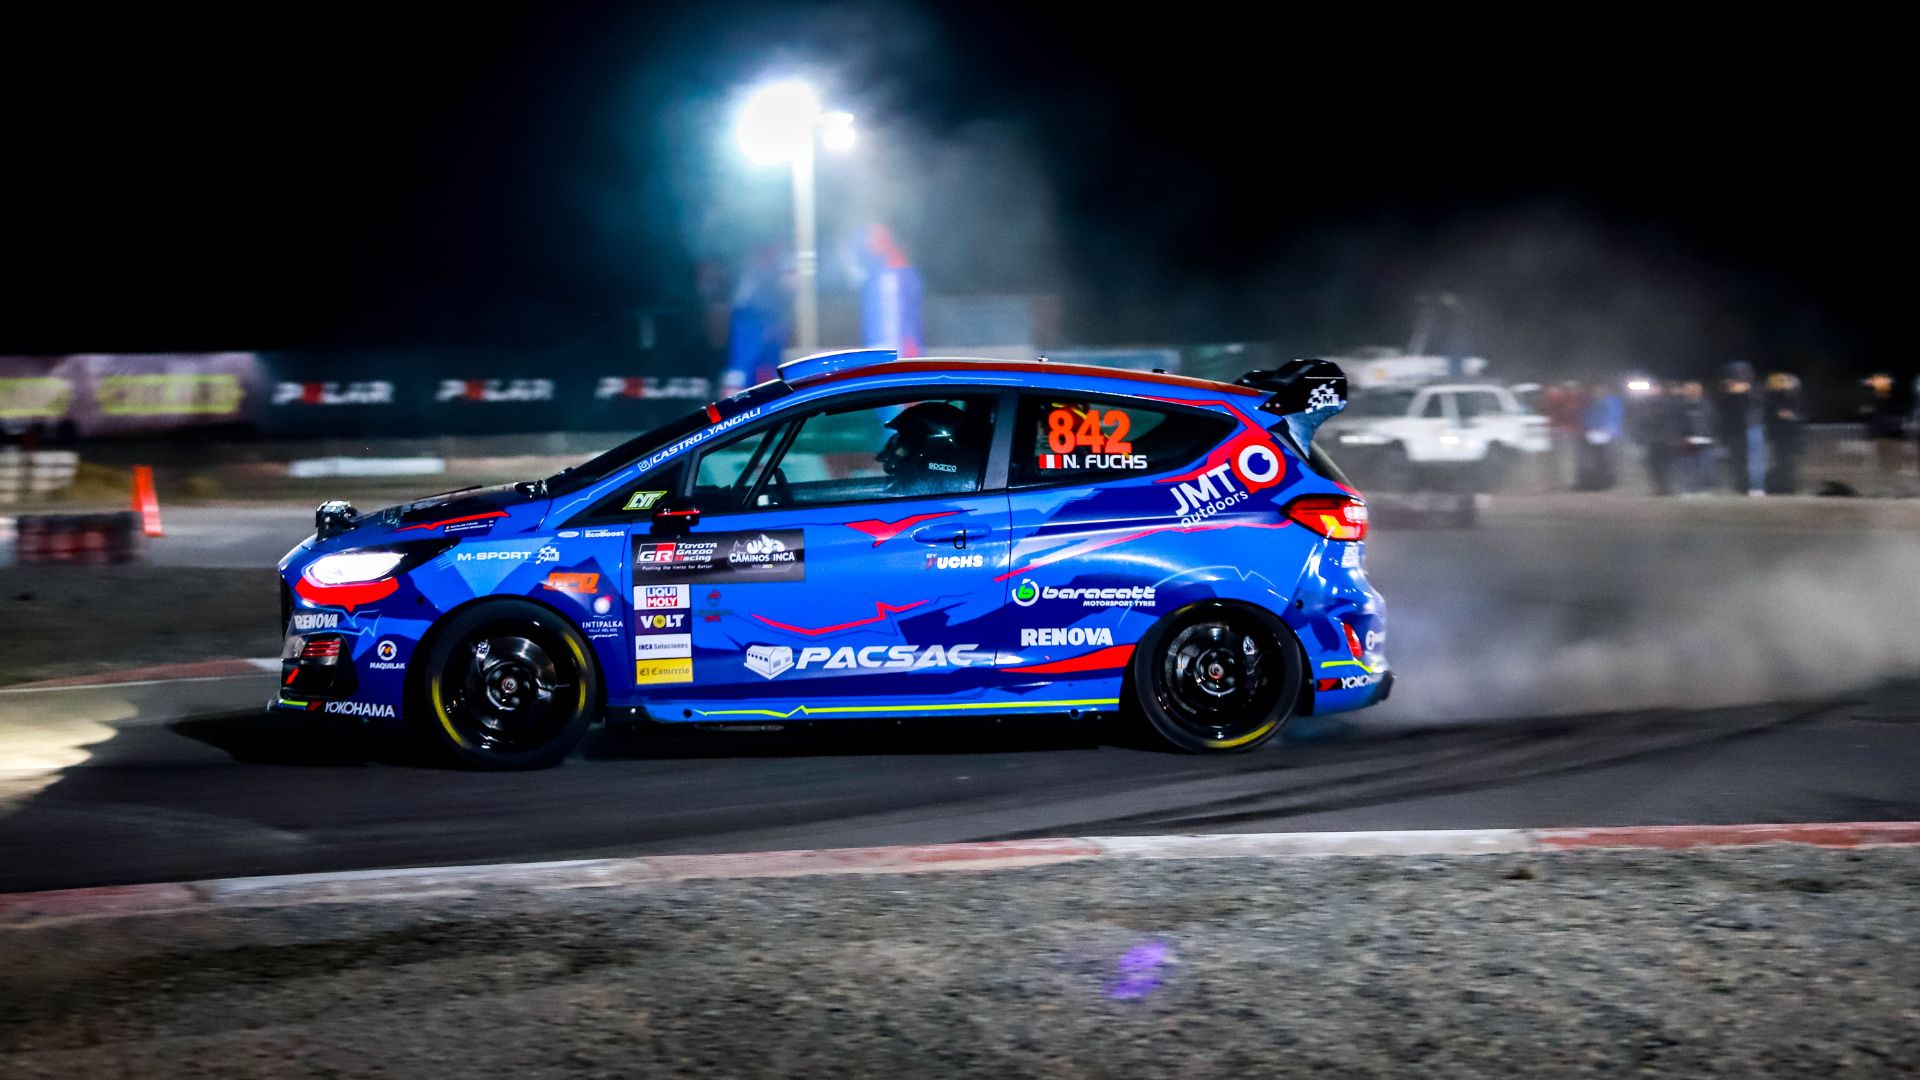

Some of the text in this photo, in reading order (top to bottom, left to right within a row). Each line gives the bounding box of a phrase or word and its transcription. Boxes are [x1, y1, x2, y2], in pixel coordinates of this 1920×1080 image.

[1048, 409, 1132, 454] 842
[1063, 454, 1148, 470] N. FUCHS
[1180, 490, 1249, 529] outdoors
[457, 551, 532, 561] M-SPORT
[639, 550, 673, 562] GR
[675, 554, 712, 562] Racing
[729, 551, 795, 563] CAMINOS INCA
[646, 587, 677, 597] LIQUI
[1042, 586, 1156, 600] baracatt
[647, 597, 678, 607] MOLY
[294, 613, 338, 630] RENOVA
[582, 620, 624, 628] INTIPALKA
[640, 614, 685, 628] VOLT
[1021, 627, 1113, 646] RENOVA
[795, 643, 980, 670] PACSAC
[369, 662, 406, 670] MAQUILAK
[640, 667, 690, 676] El Comercio
[325, 701, 396, 718] YOKOHAMA
